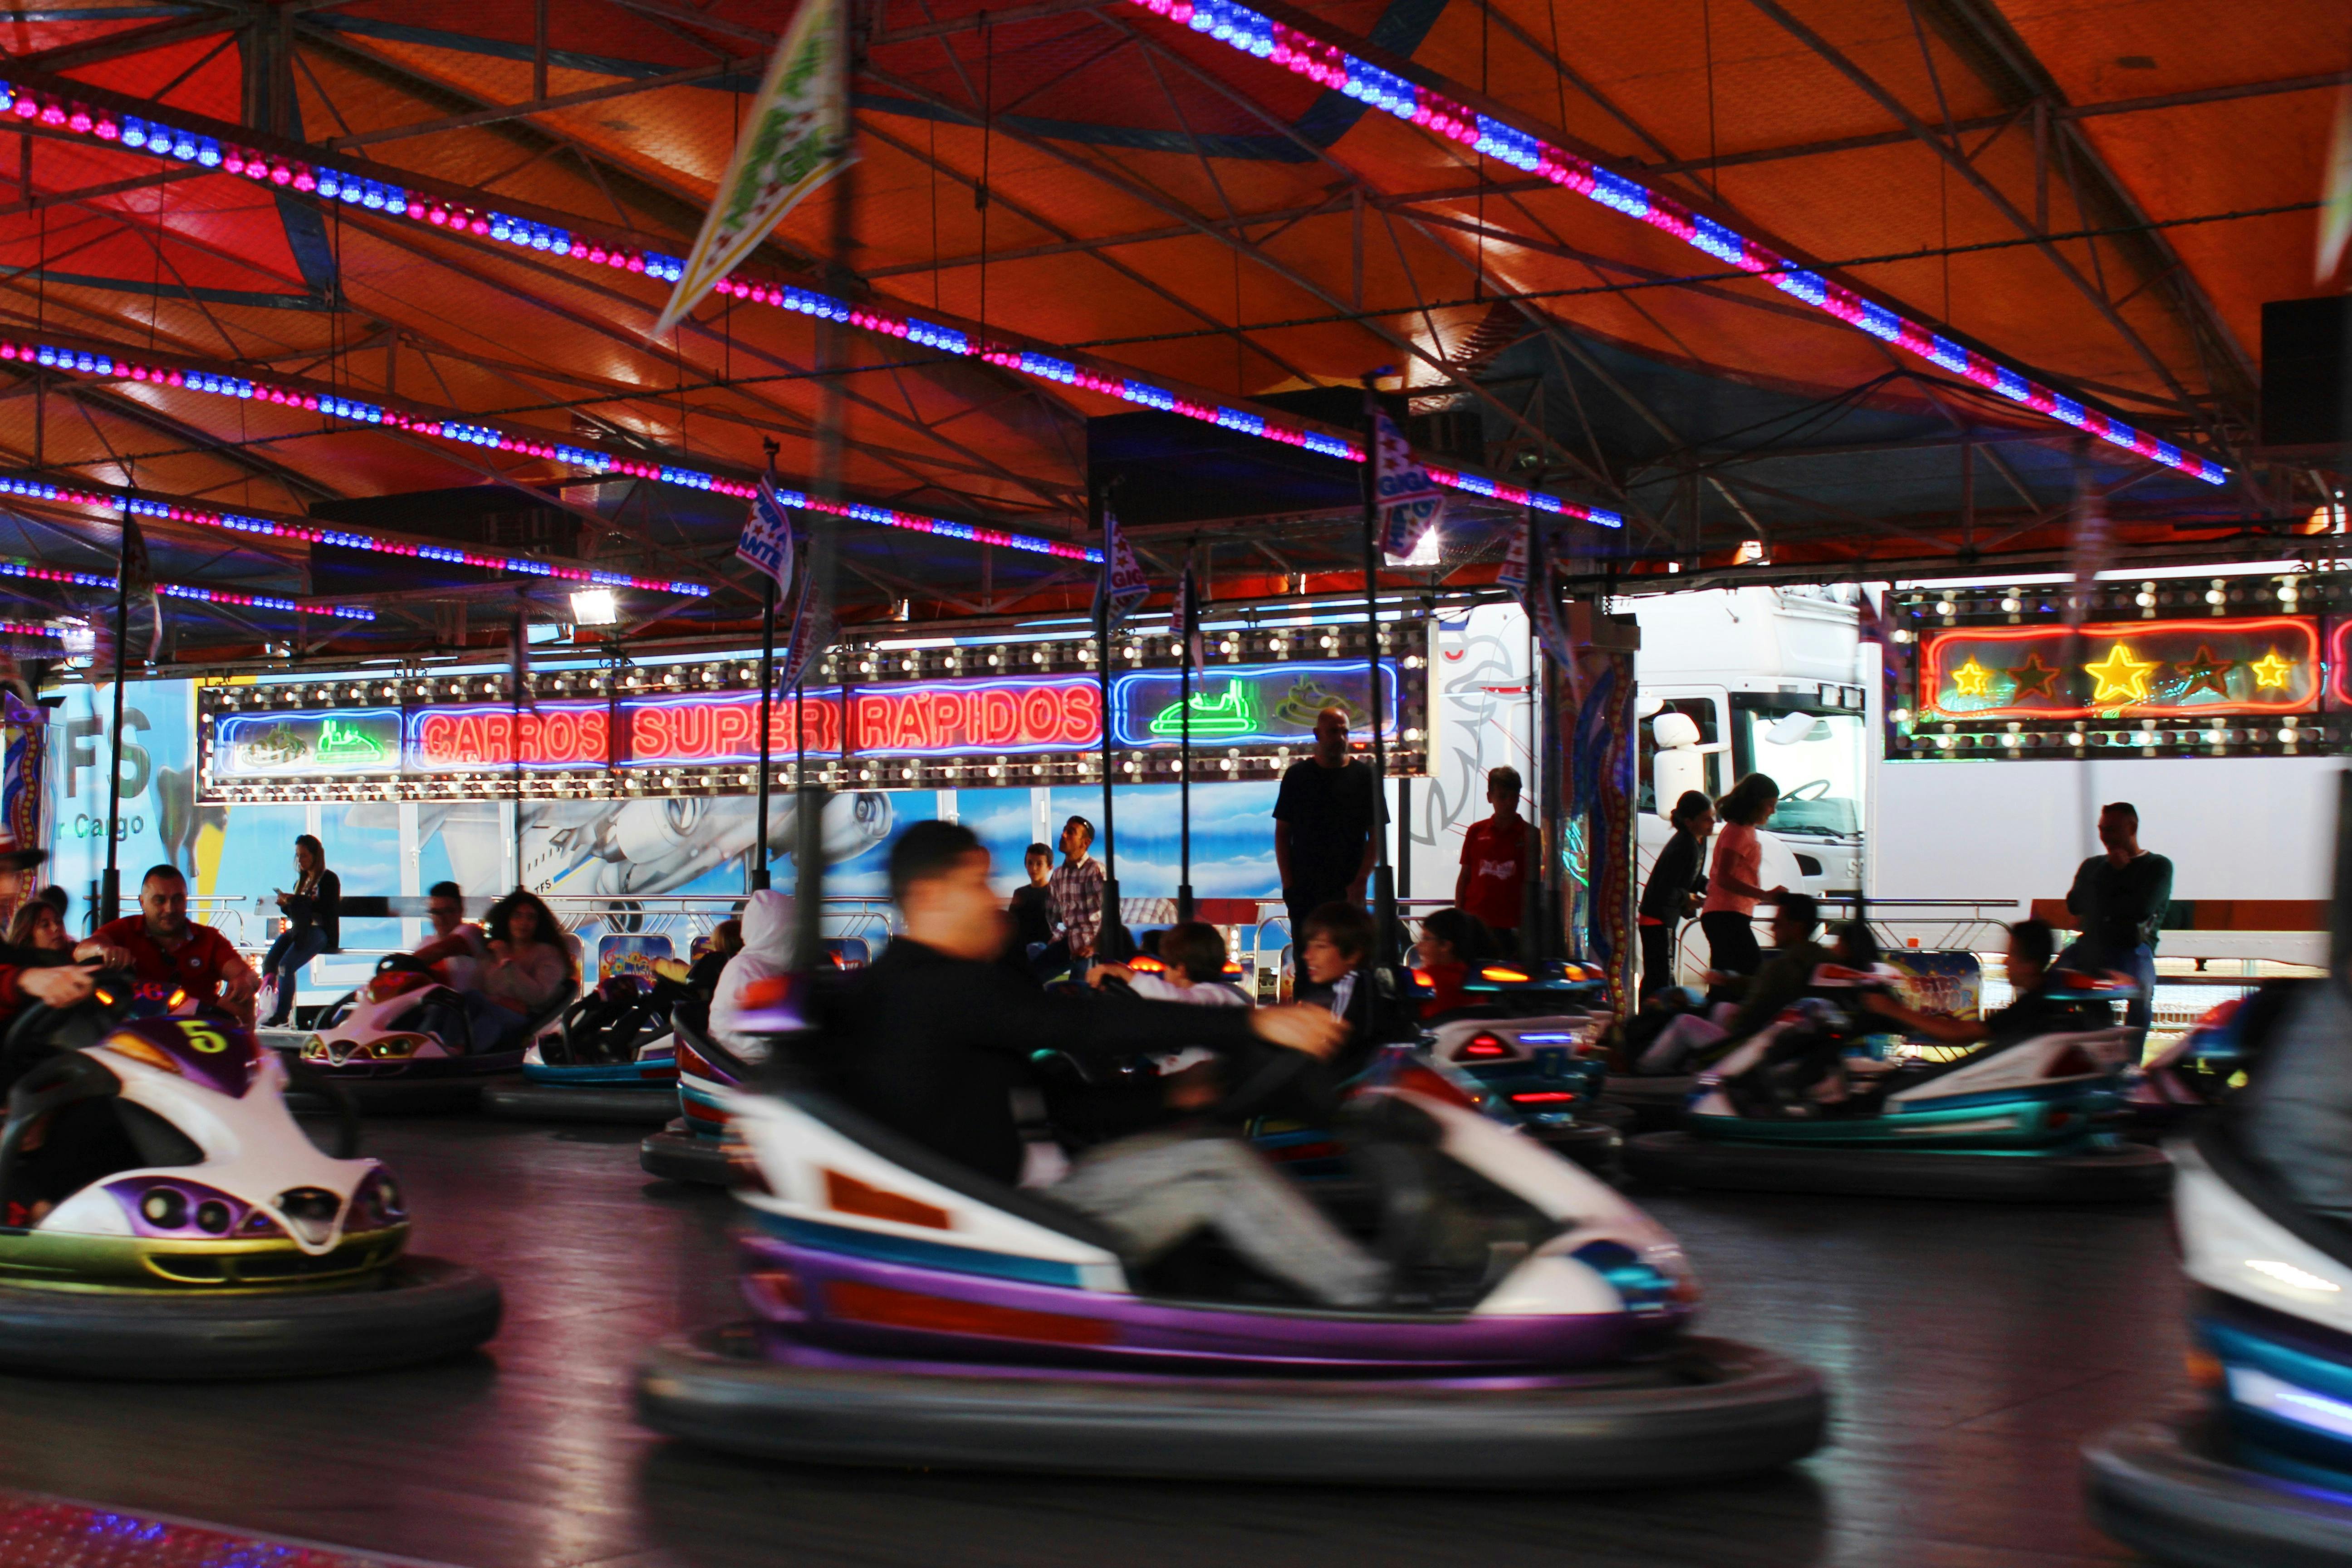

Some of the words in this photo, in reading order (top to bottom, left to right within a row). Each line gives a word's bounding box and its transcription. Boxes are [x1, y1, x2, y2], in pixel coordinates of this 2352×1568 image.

[422, 710, 609, 763] CARROS
[632, 699, 840, 759] SUPER
[534, 878, 552, 894] TFS
[176, 1020, 228, 1054] 5
